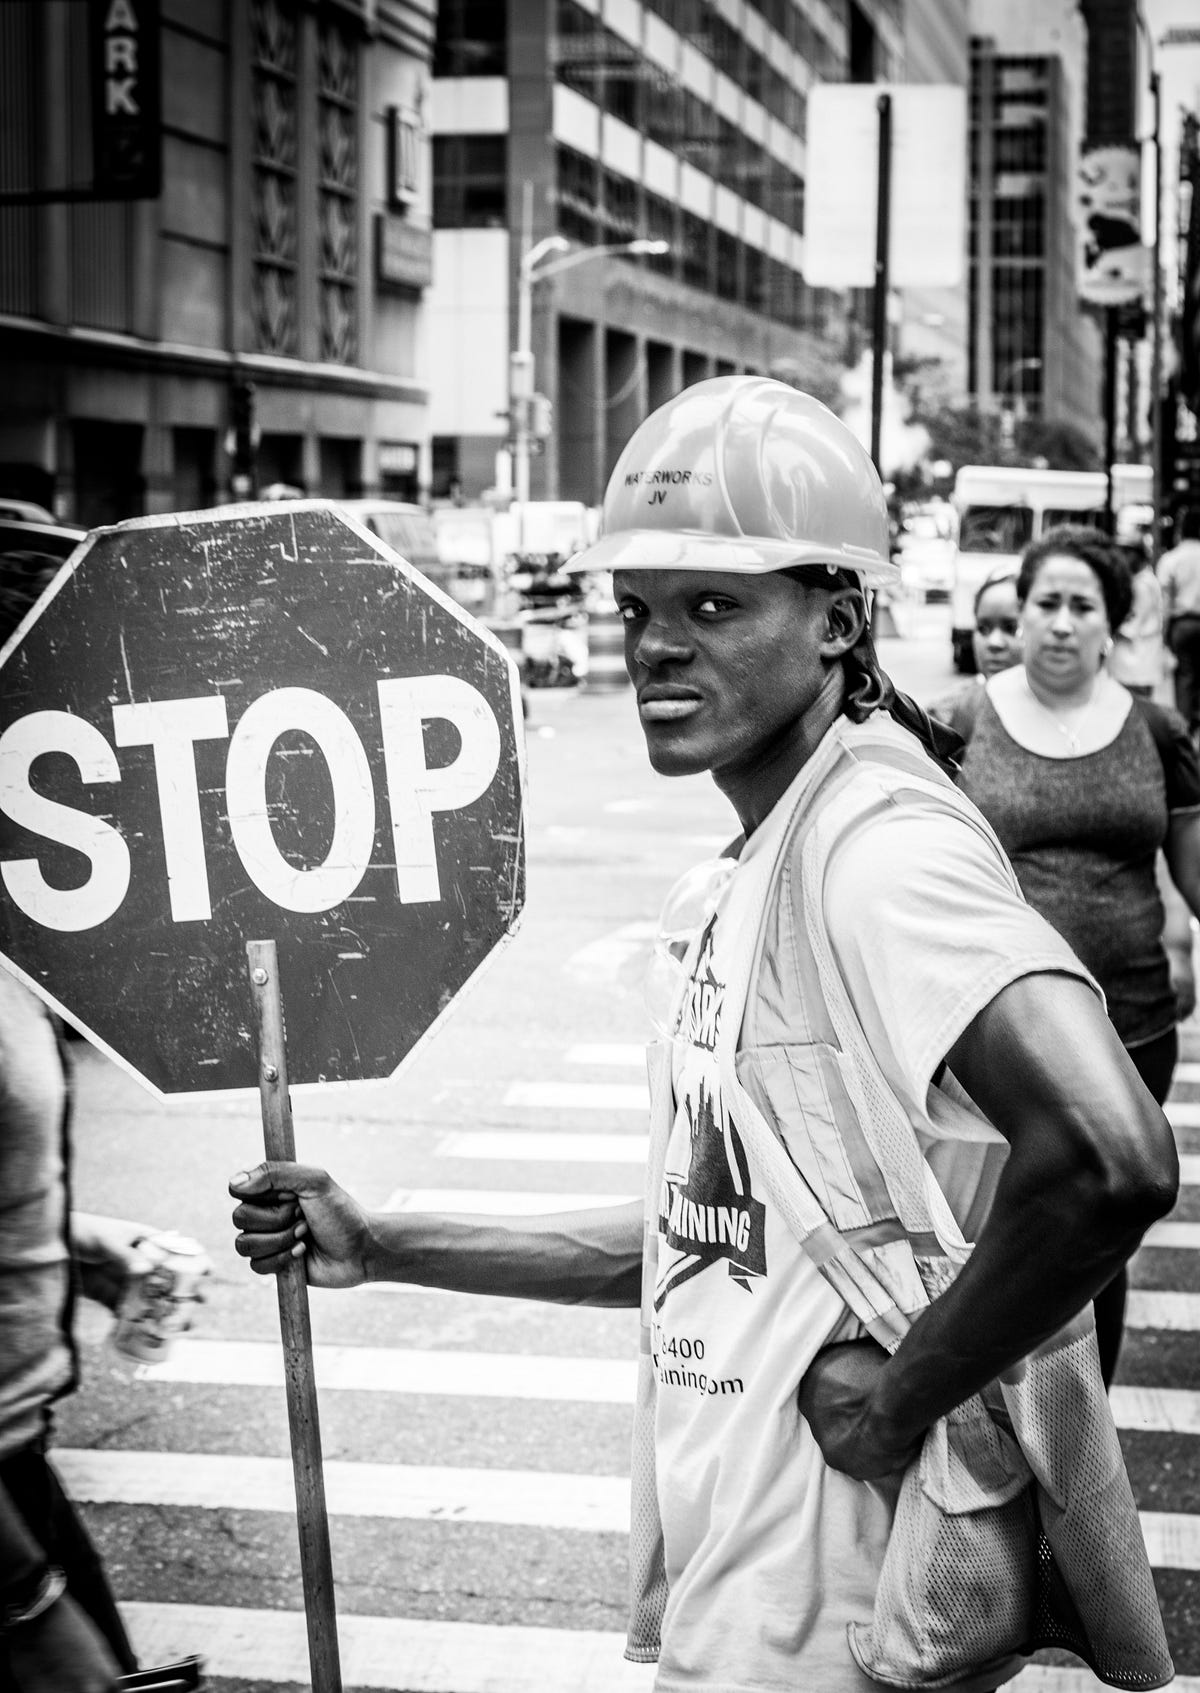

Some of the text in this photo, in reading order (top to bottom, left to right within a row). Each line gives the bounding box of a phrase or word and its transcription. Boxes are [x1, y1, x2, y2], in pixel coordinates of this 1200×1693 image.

[105, 0, 139, 115] ARK
[625, 470, 713, 487] WATERWORKS
[648, 490, 667, 506] JV
[0, 674, 501, 932] STOP
[659, 1181, 751, 1253] AINING
